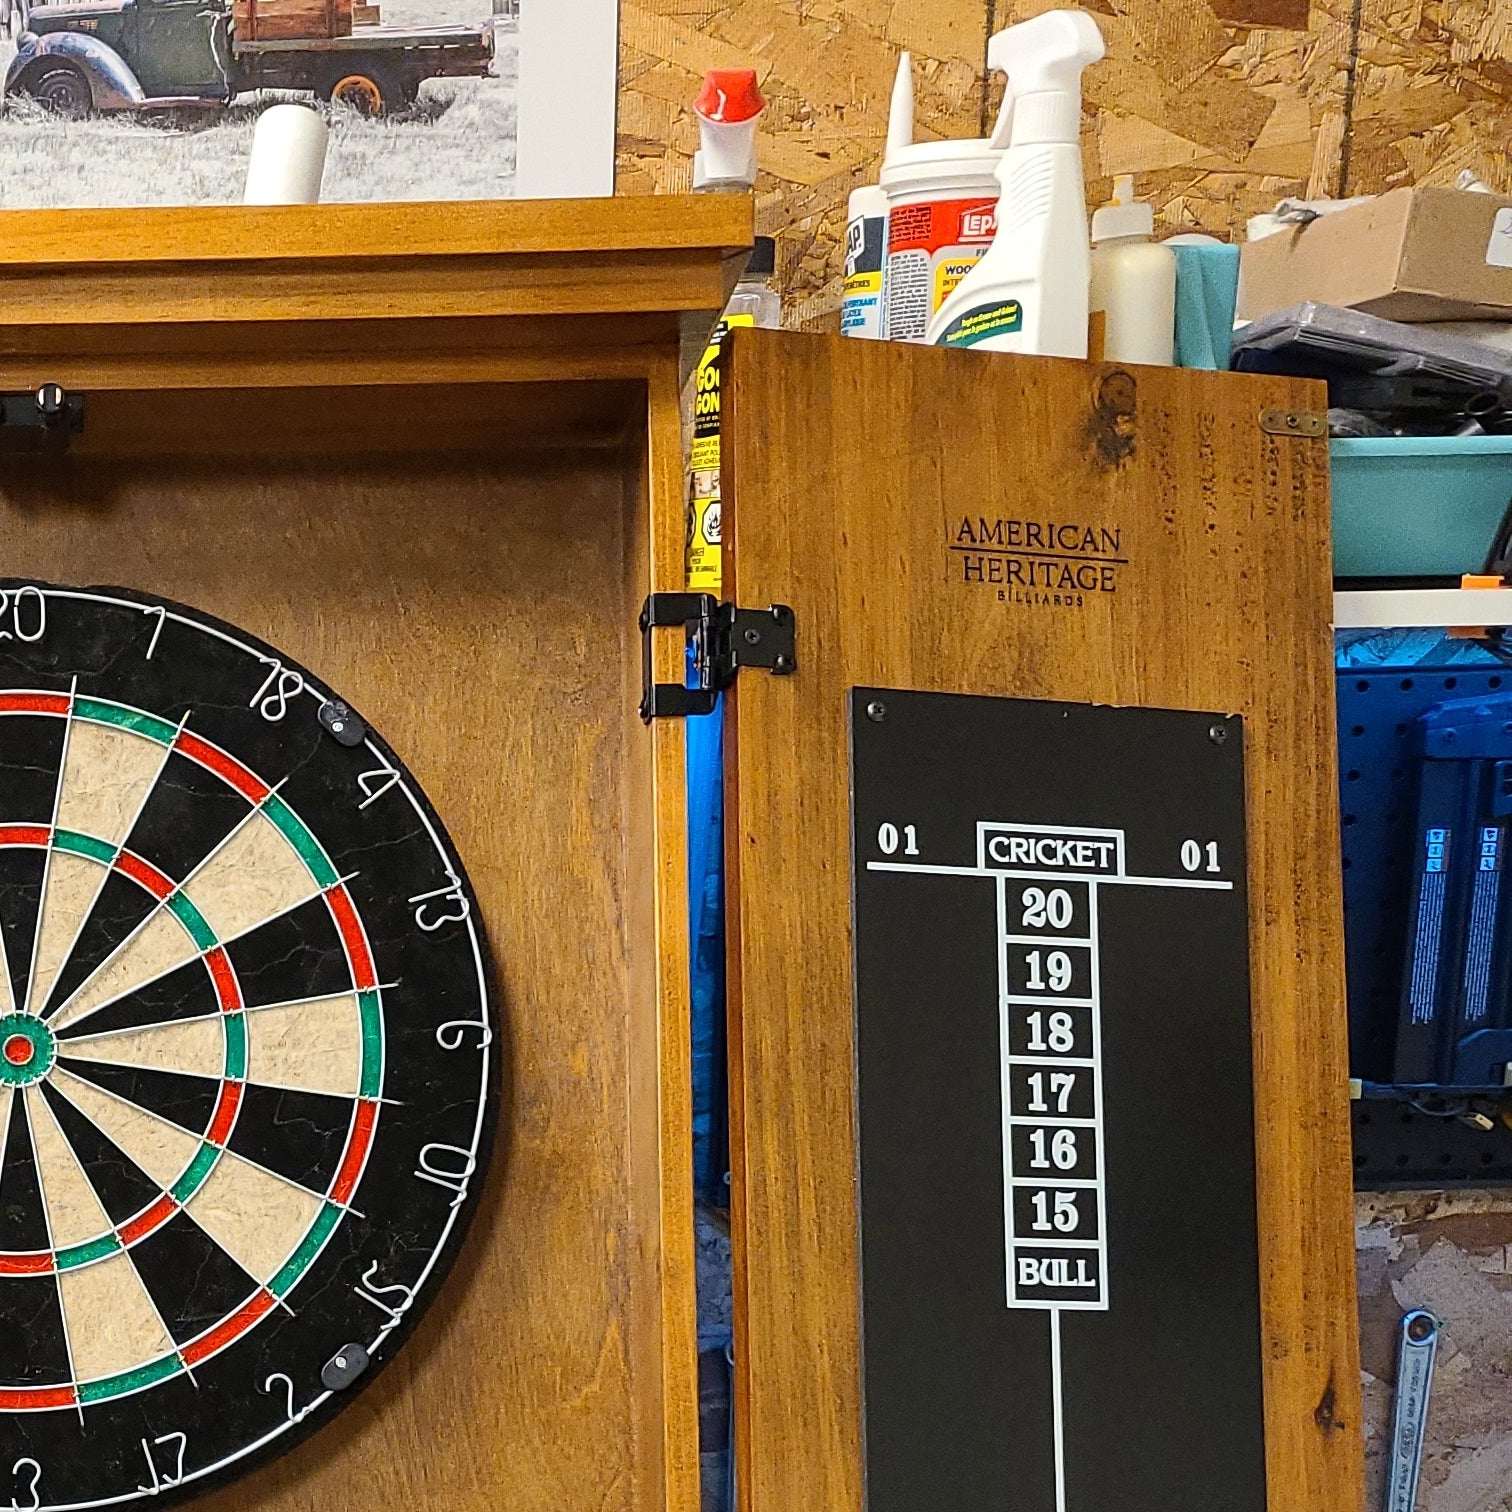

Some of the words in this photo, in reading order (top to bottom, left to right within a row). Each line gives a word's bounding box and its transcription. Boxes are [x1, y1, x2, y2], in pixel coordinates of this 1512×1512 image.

[945, 264, 975, 275] WOO
[956, 517, 1121, 553] AMERICAN
[963, 556, 1116, 593] HERITAGE
[997, 590, 1083, 606] BILLIARDS
[250, 656, 304, 721] 18
[357, 769, 401, 810] 4
[878, 822, 919, 856] 01
[989, 837, 1114, 868] CRICKET
[1180, 840, 1221, 873] 01
[408, 870, 470, 931] 13
[1021, 887, 1073, 929] 20
[1025, 950, 1072, 991] 19
[437, 1020, 492, 1050] 6
[1026, 1011, 1074, 1052] 18
[1027, 1072, 1076, 1113] 17
[1029, 1129, 1077, 1170] 16
[414, 1143, 476, 1207] 10
[1031, 1191, 1079, 1232] 15
[1018, 1258, 1096, 1288] BULL
[354, 1259, 414, 1330] 15
[138, 1432, 187, 1496] 17
